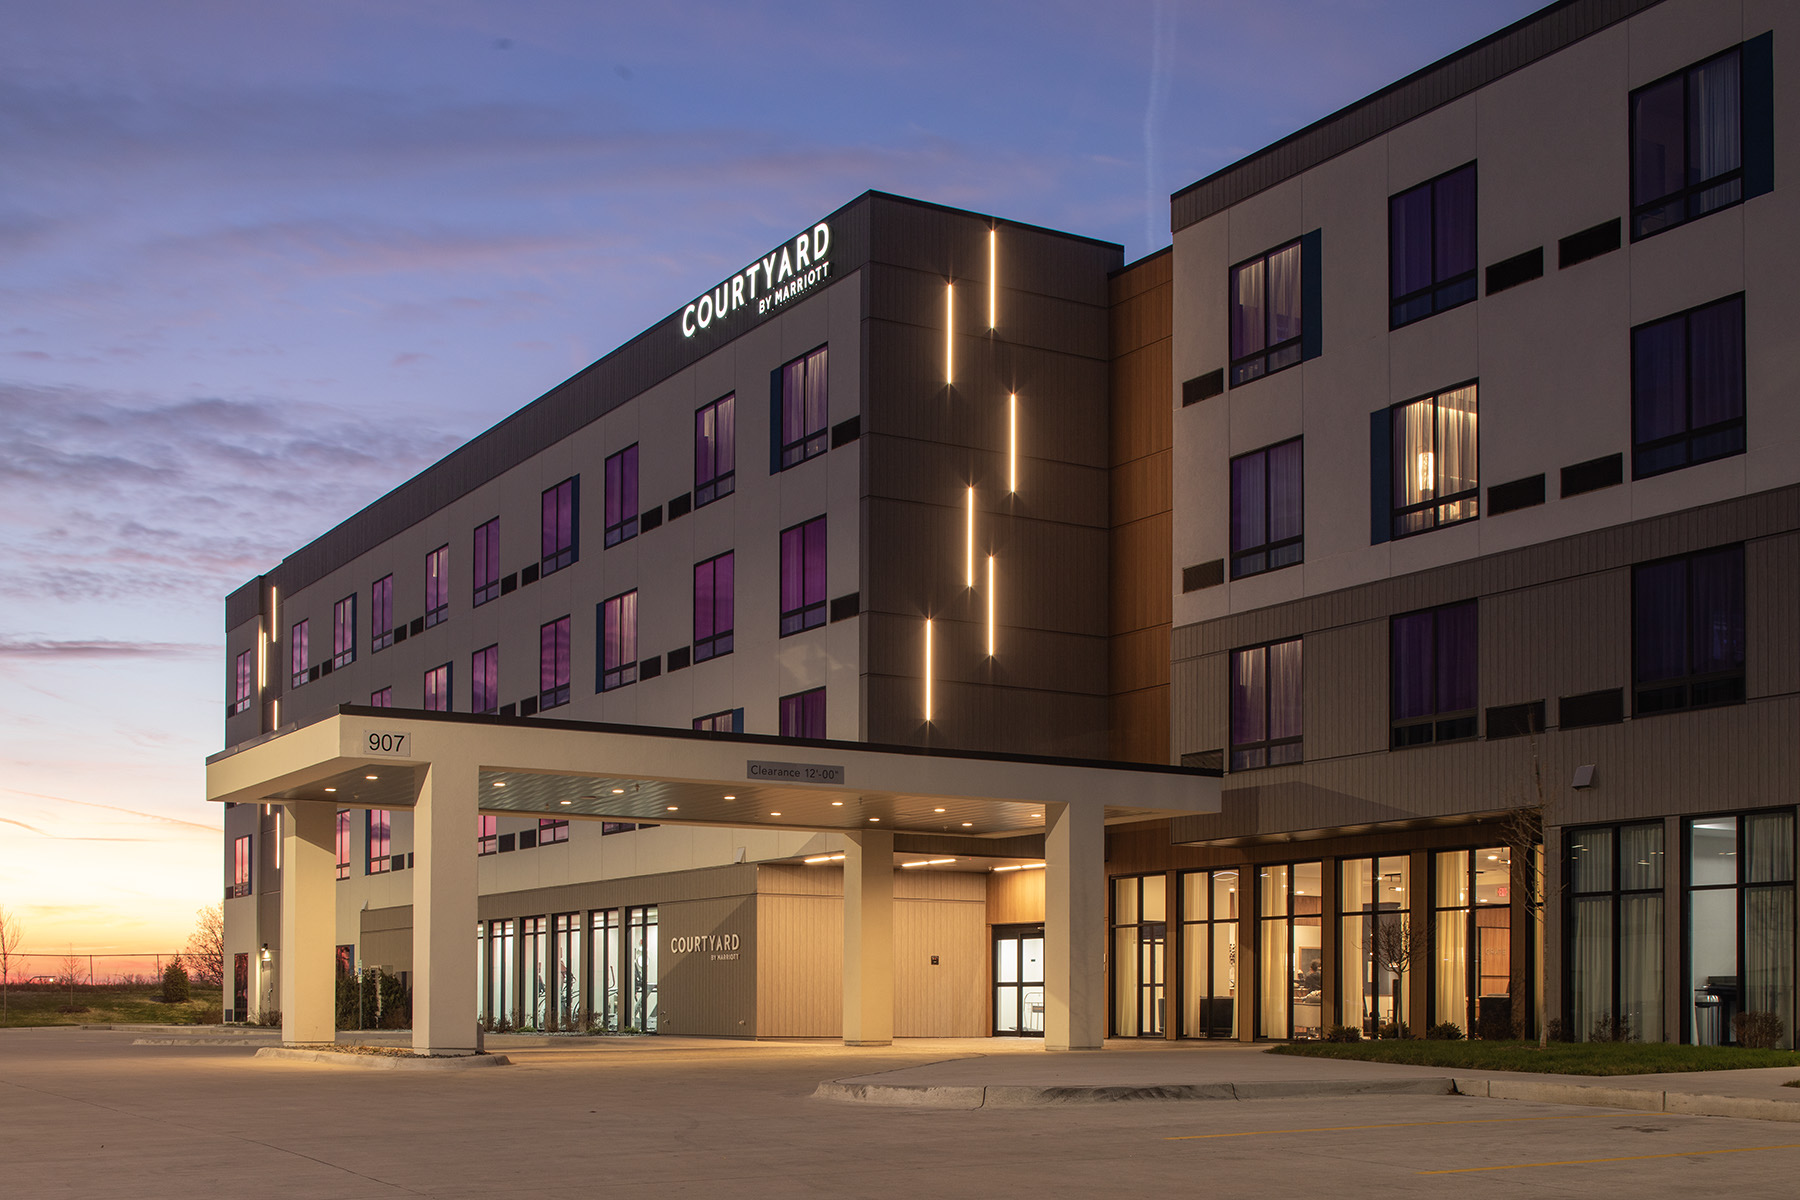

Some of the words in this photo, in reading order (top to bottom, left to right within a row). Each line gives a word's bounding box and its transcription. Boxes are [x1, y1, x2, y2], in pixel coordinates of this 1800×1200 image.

[682, 222, 830, 338] COURTYARD
[758, 295, 772, 315] BY
[774, 261, 830, 306] MARRIOTT
[369, 733, 405, 752] 907
[750, 765, 801, 778] Clearance
[670, 933, 740, 954] COURTYARD
